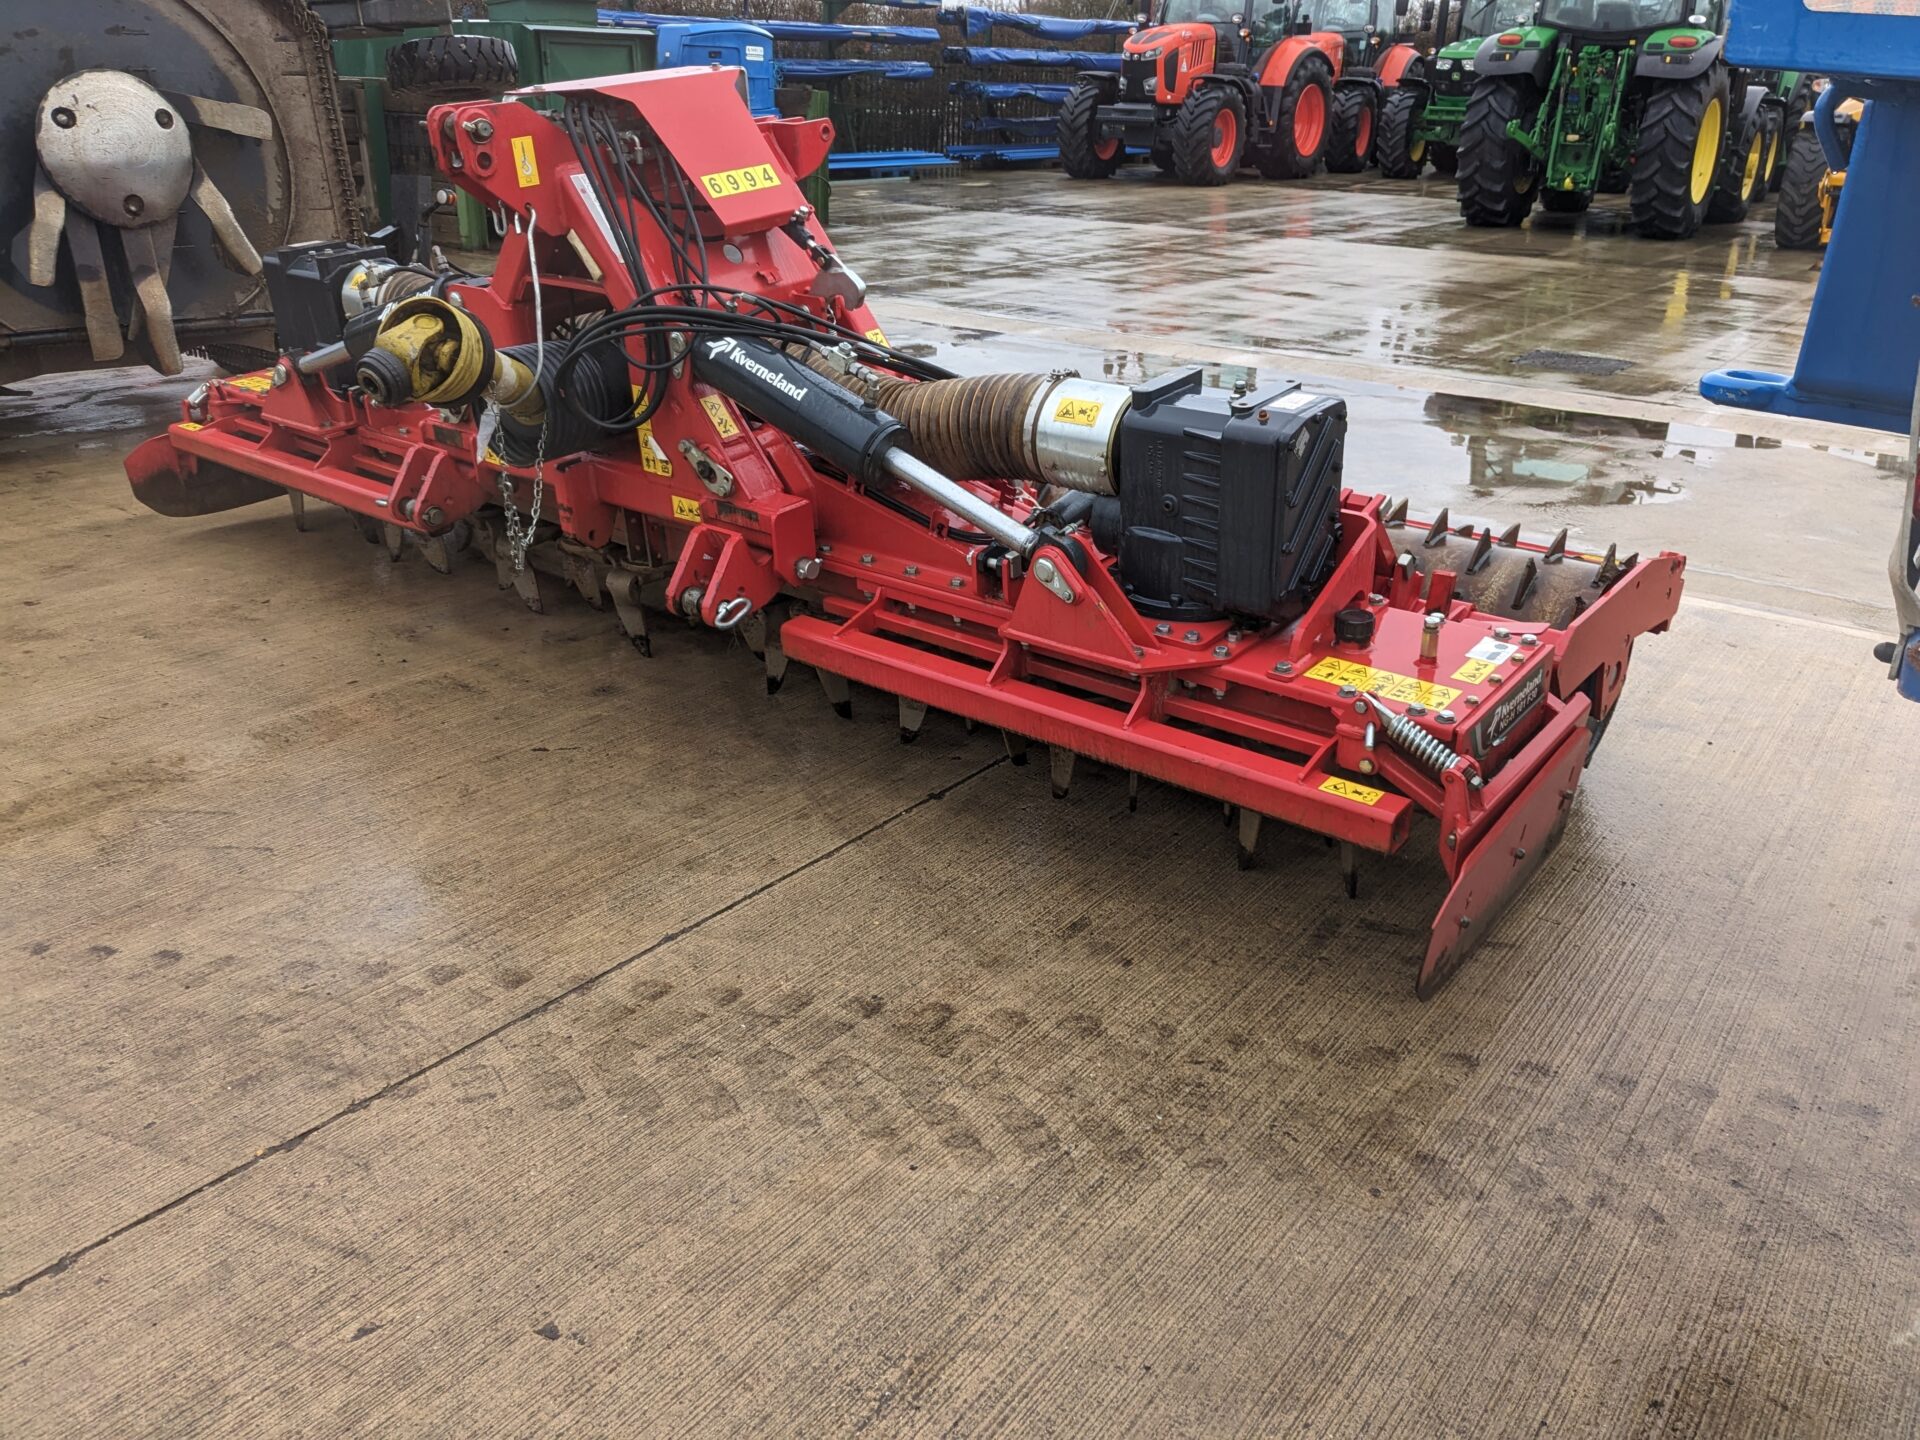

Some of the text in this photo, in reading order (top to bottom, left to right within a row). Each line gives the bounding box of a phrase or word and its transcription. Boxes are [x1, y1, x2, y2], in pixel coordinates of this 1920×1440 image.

[708, 167, 774, 194] 6994
[729, 346, 808, 401] Kverneland
[1501, 668, 1543, 718] Kverneland
